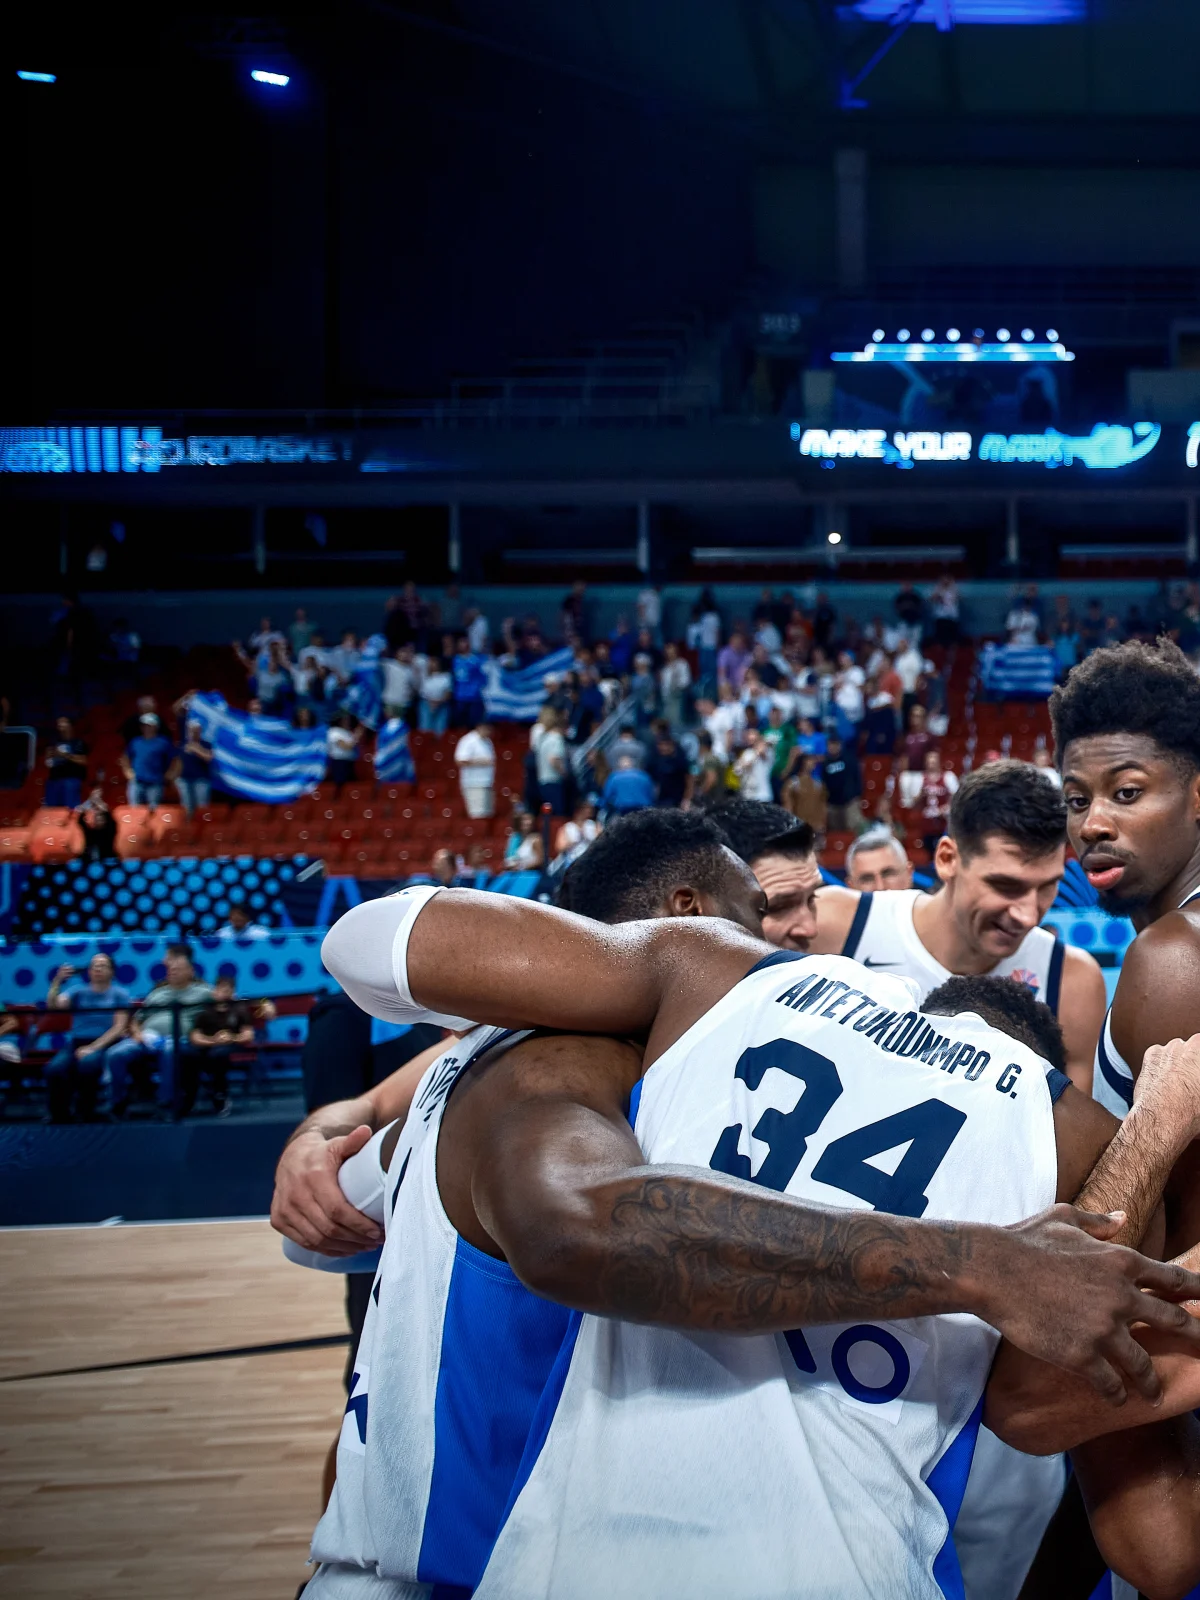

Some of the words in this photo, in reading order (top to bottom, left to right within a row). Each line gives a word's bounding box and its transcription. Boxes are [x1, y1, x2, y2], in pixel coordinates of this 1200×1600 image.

[800, 429, 886, 459] MAKE
[894, 432, 971, 460] YOUR
[775, 973, 991, 1081] ANTETOKOUNMPO
[995, 1062, 1022, 1099] G.
[709, 1038, 967, 1218] 34
